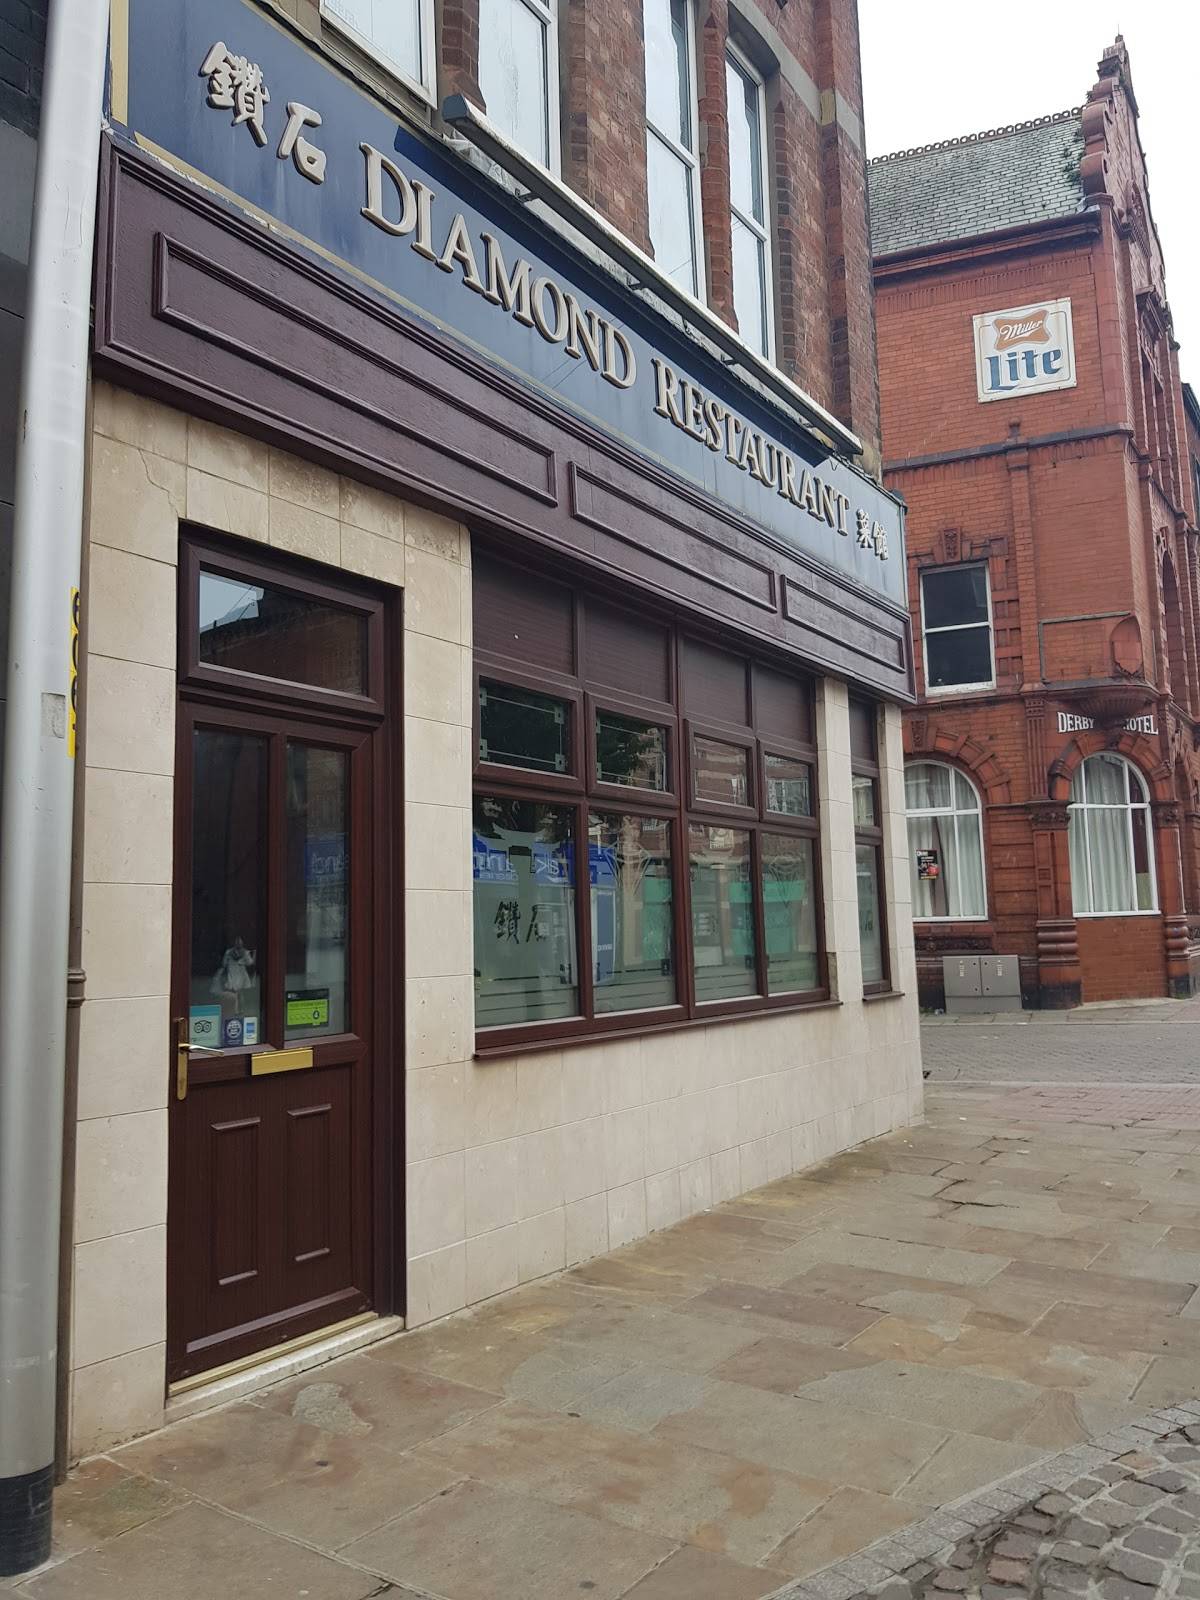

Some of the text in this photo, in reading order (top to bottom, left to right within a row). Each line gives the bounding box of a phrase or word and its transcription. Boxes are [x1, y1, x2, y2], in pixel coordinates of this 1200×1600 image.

[360, 142, 637, 389] DIAMOND
[653, 358, 850, 536] RESTAURANT
[1001, 320, 1043, 340] Miller
[985, 348, 1062, 391] Lite
[1057, 712, 1094, 732] DERBY
